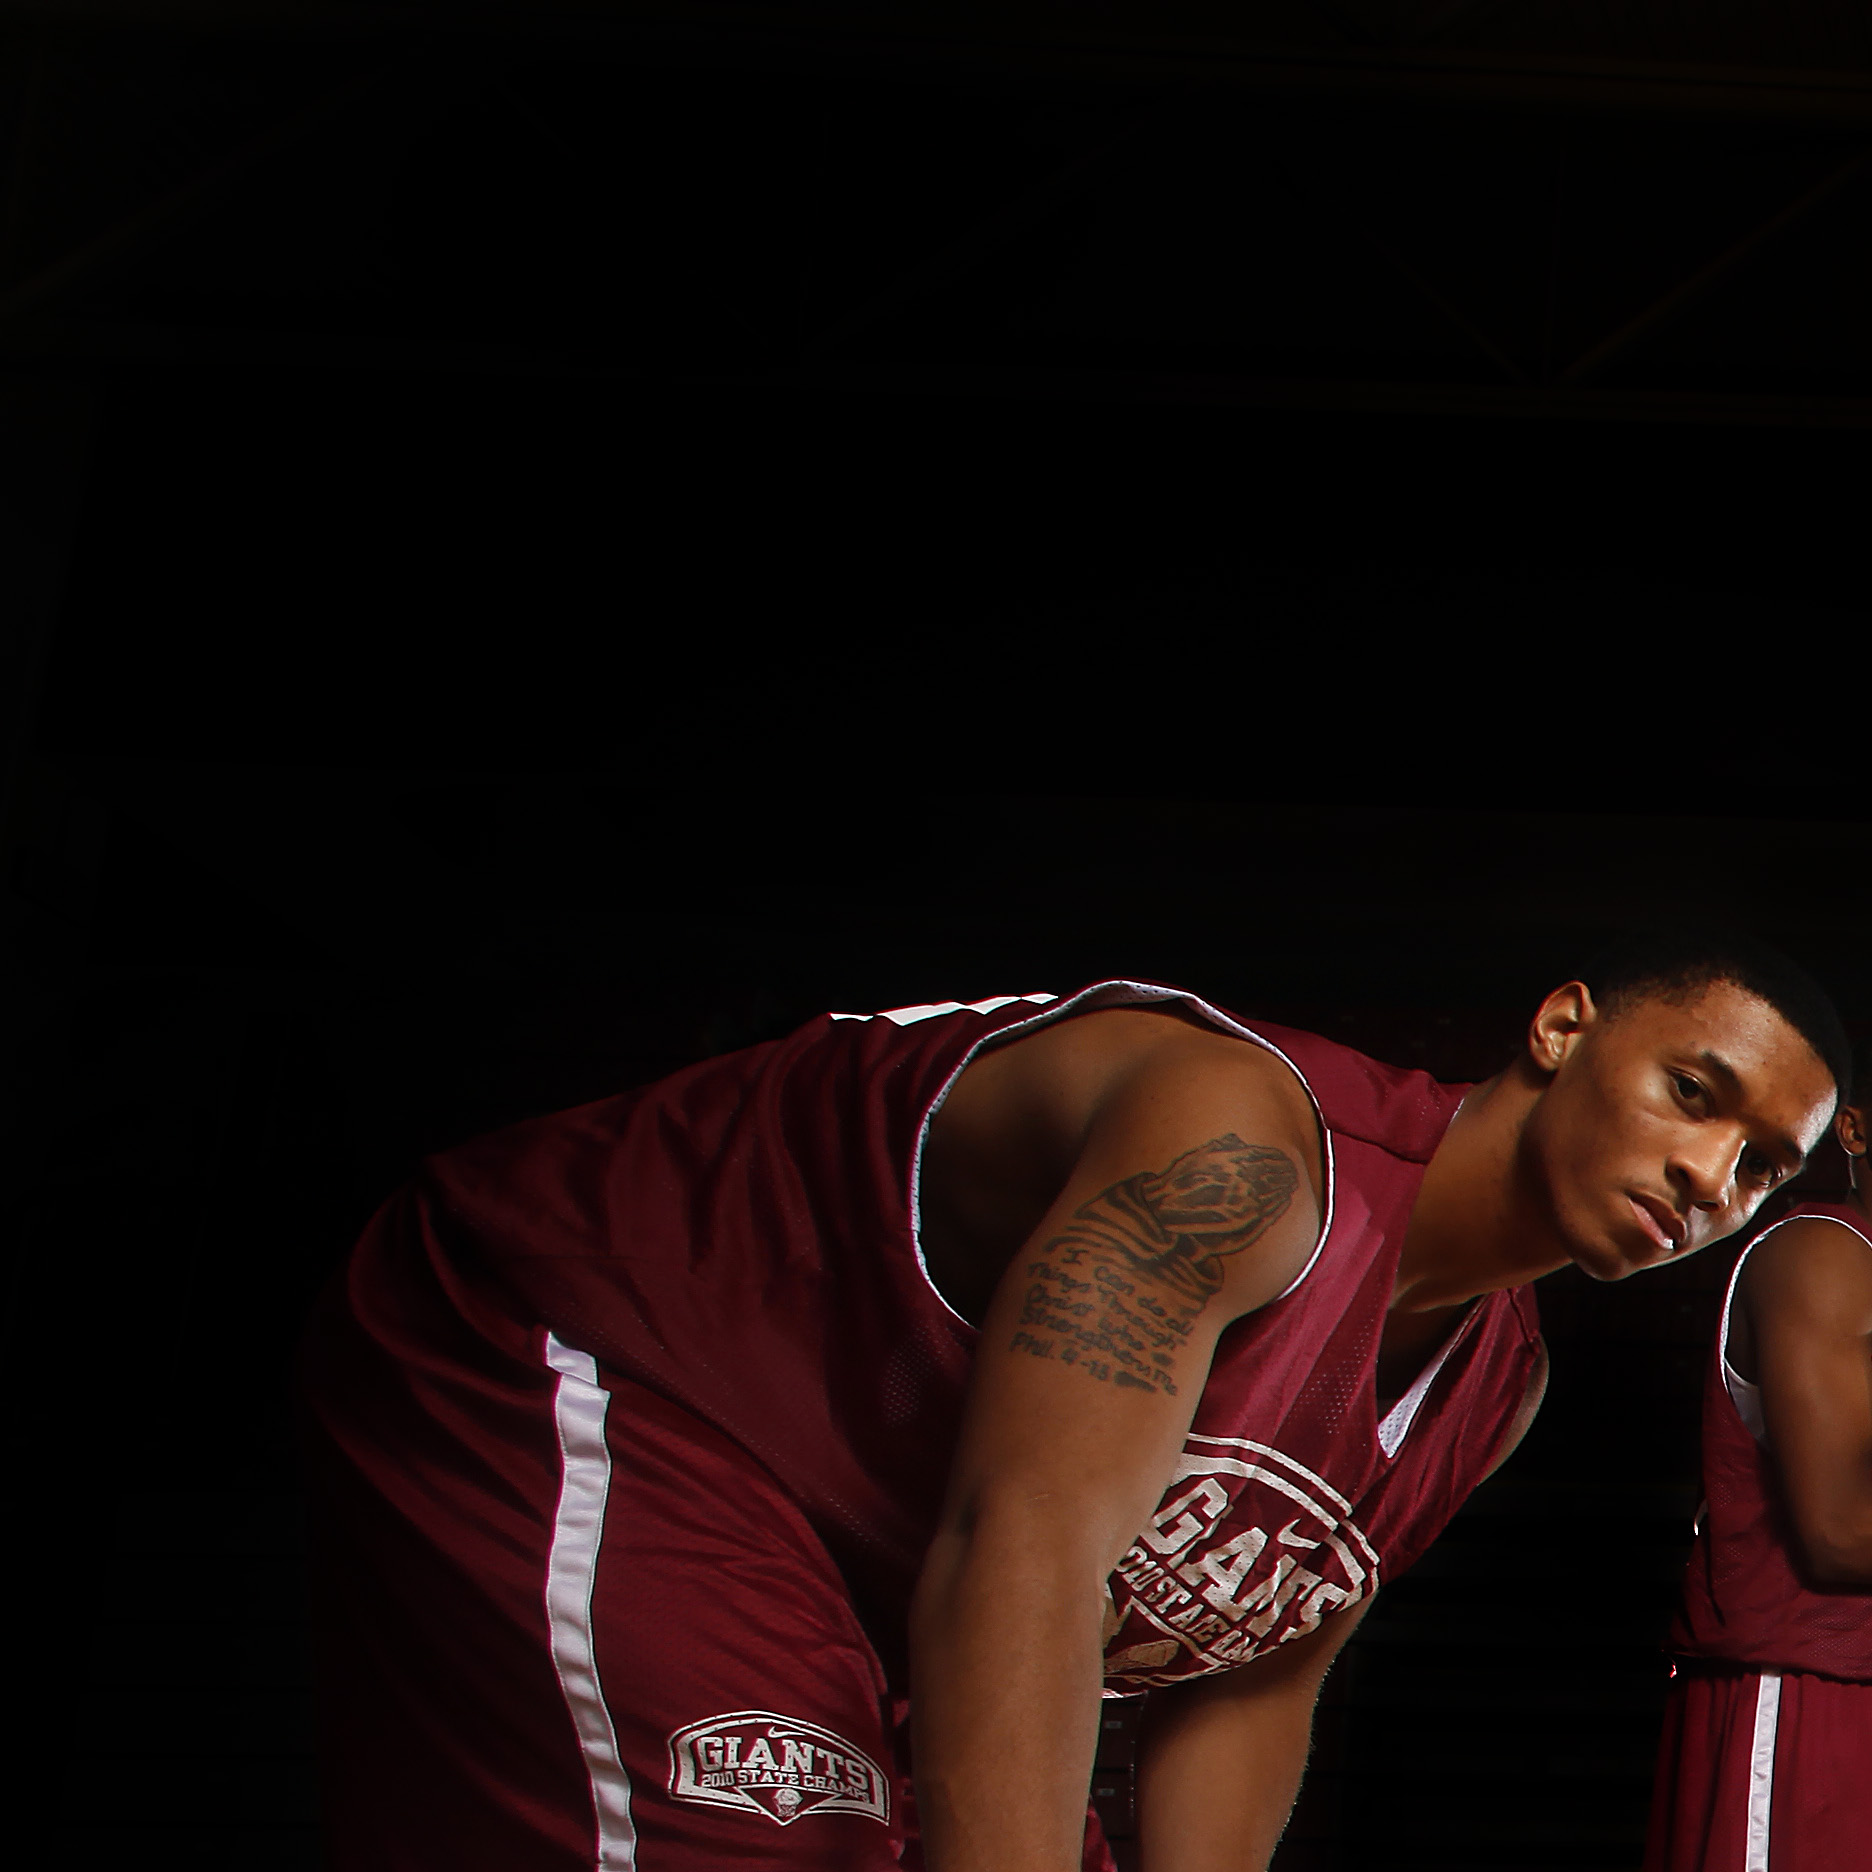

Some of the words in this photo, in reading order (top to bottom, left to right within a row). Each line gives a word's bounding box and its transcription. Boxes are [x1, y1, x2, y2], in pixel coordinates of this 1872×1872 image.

[696, 1736, 870, 1796] GIANTS
[700, 1770, 736, 1788] 2010
[737, 1769, 801, 1787] STATE
[802, 1773, 871, 1805] CHAMPS
